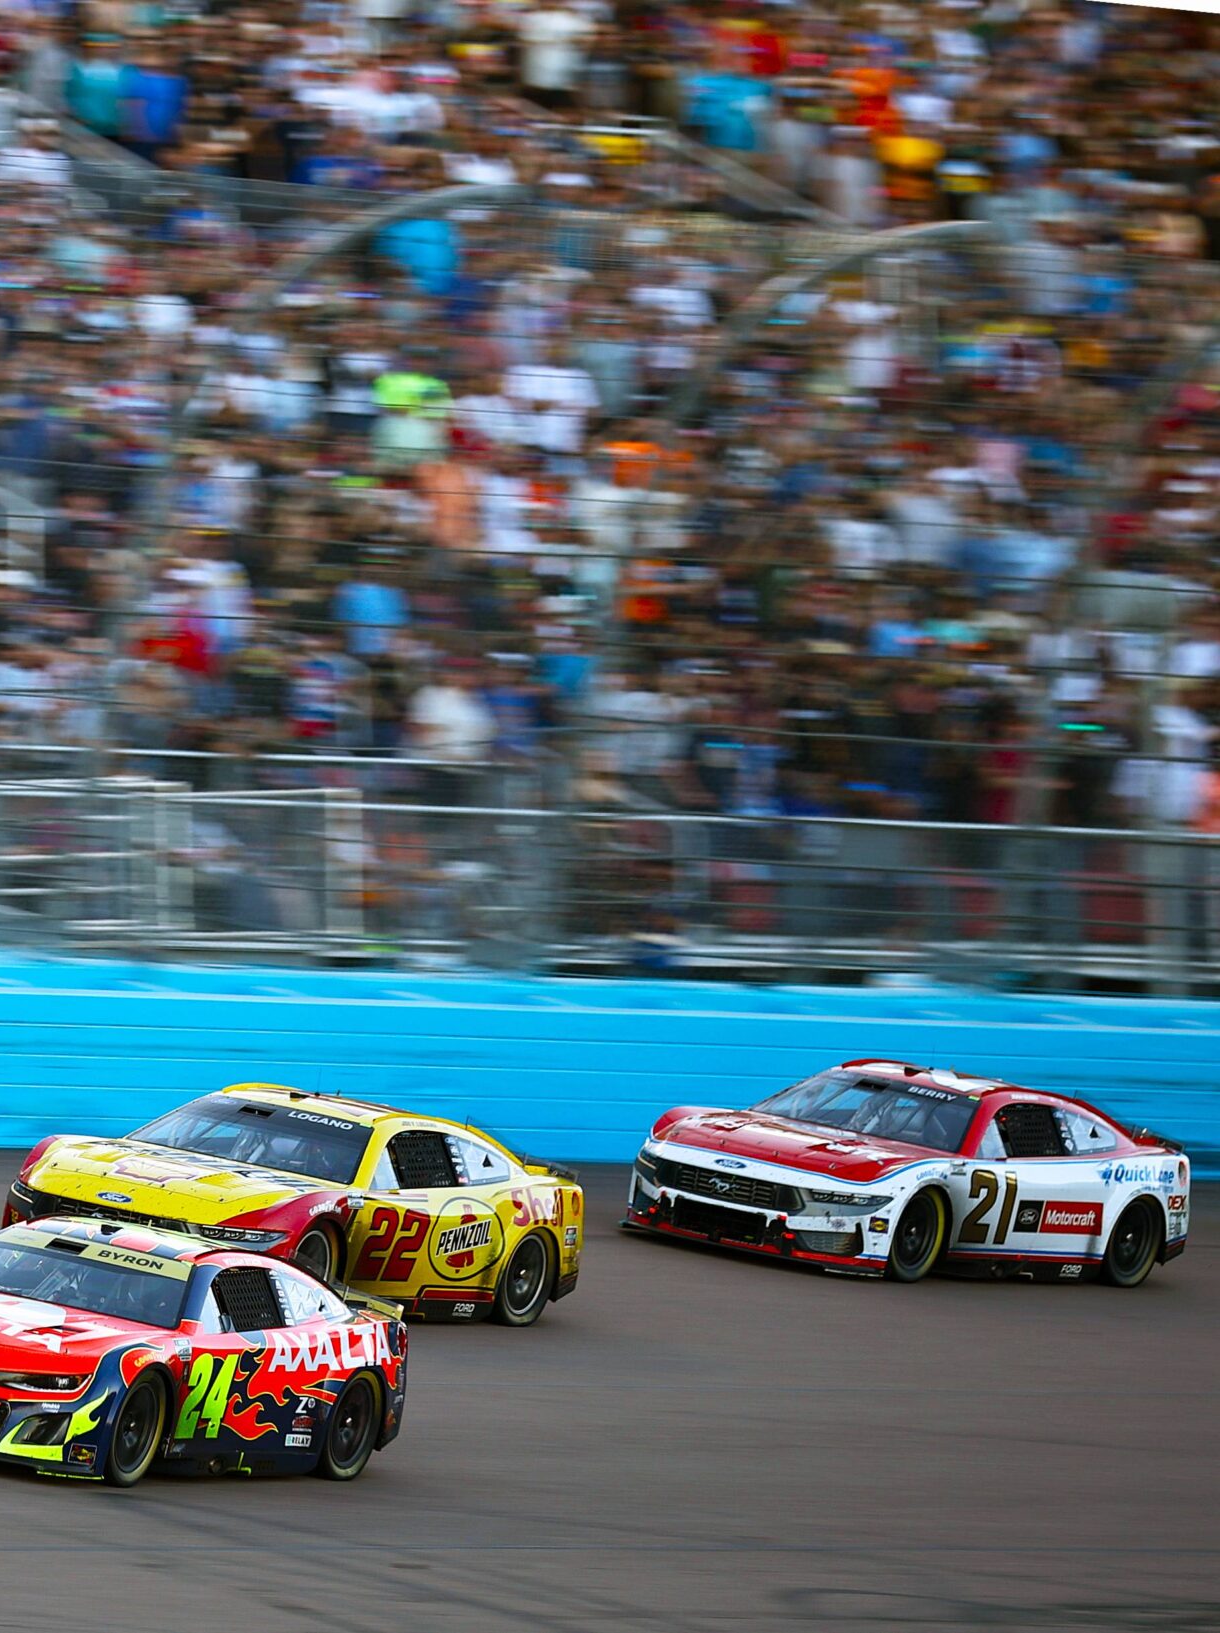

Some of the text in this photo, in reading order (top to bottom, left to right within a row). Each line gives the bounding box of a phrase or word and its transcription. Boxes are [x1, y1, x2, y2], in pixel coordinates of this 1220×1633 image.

[907, 1086, 957, 1101] BERRY
[288, 1111, 353, 1130] LOGANO
[958, 1169, 1018, 1245] 21
[1045, 1209, 1096, 1227] Motorcraft
[350, 1207, 431, 1281] 22
[435, 1220, 493, 1257] PENNZOIL
[97, 1250, 165, 1270] BYRON
[1060, 1264, 1082, 1274] FORD
[453, 1303, 476, 1313] FORD
[268, 1322, 393, 1373] AXALTA
[174, 1352, 240, 1439] 24
